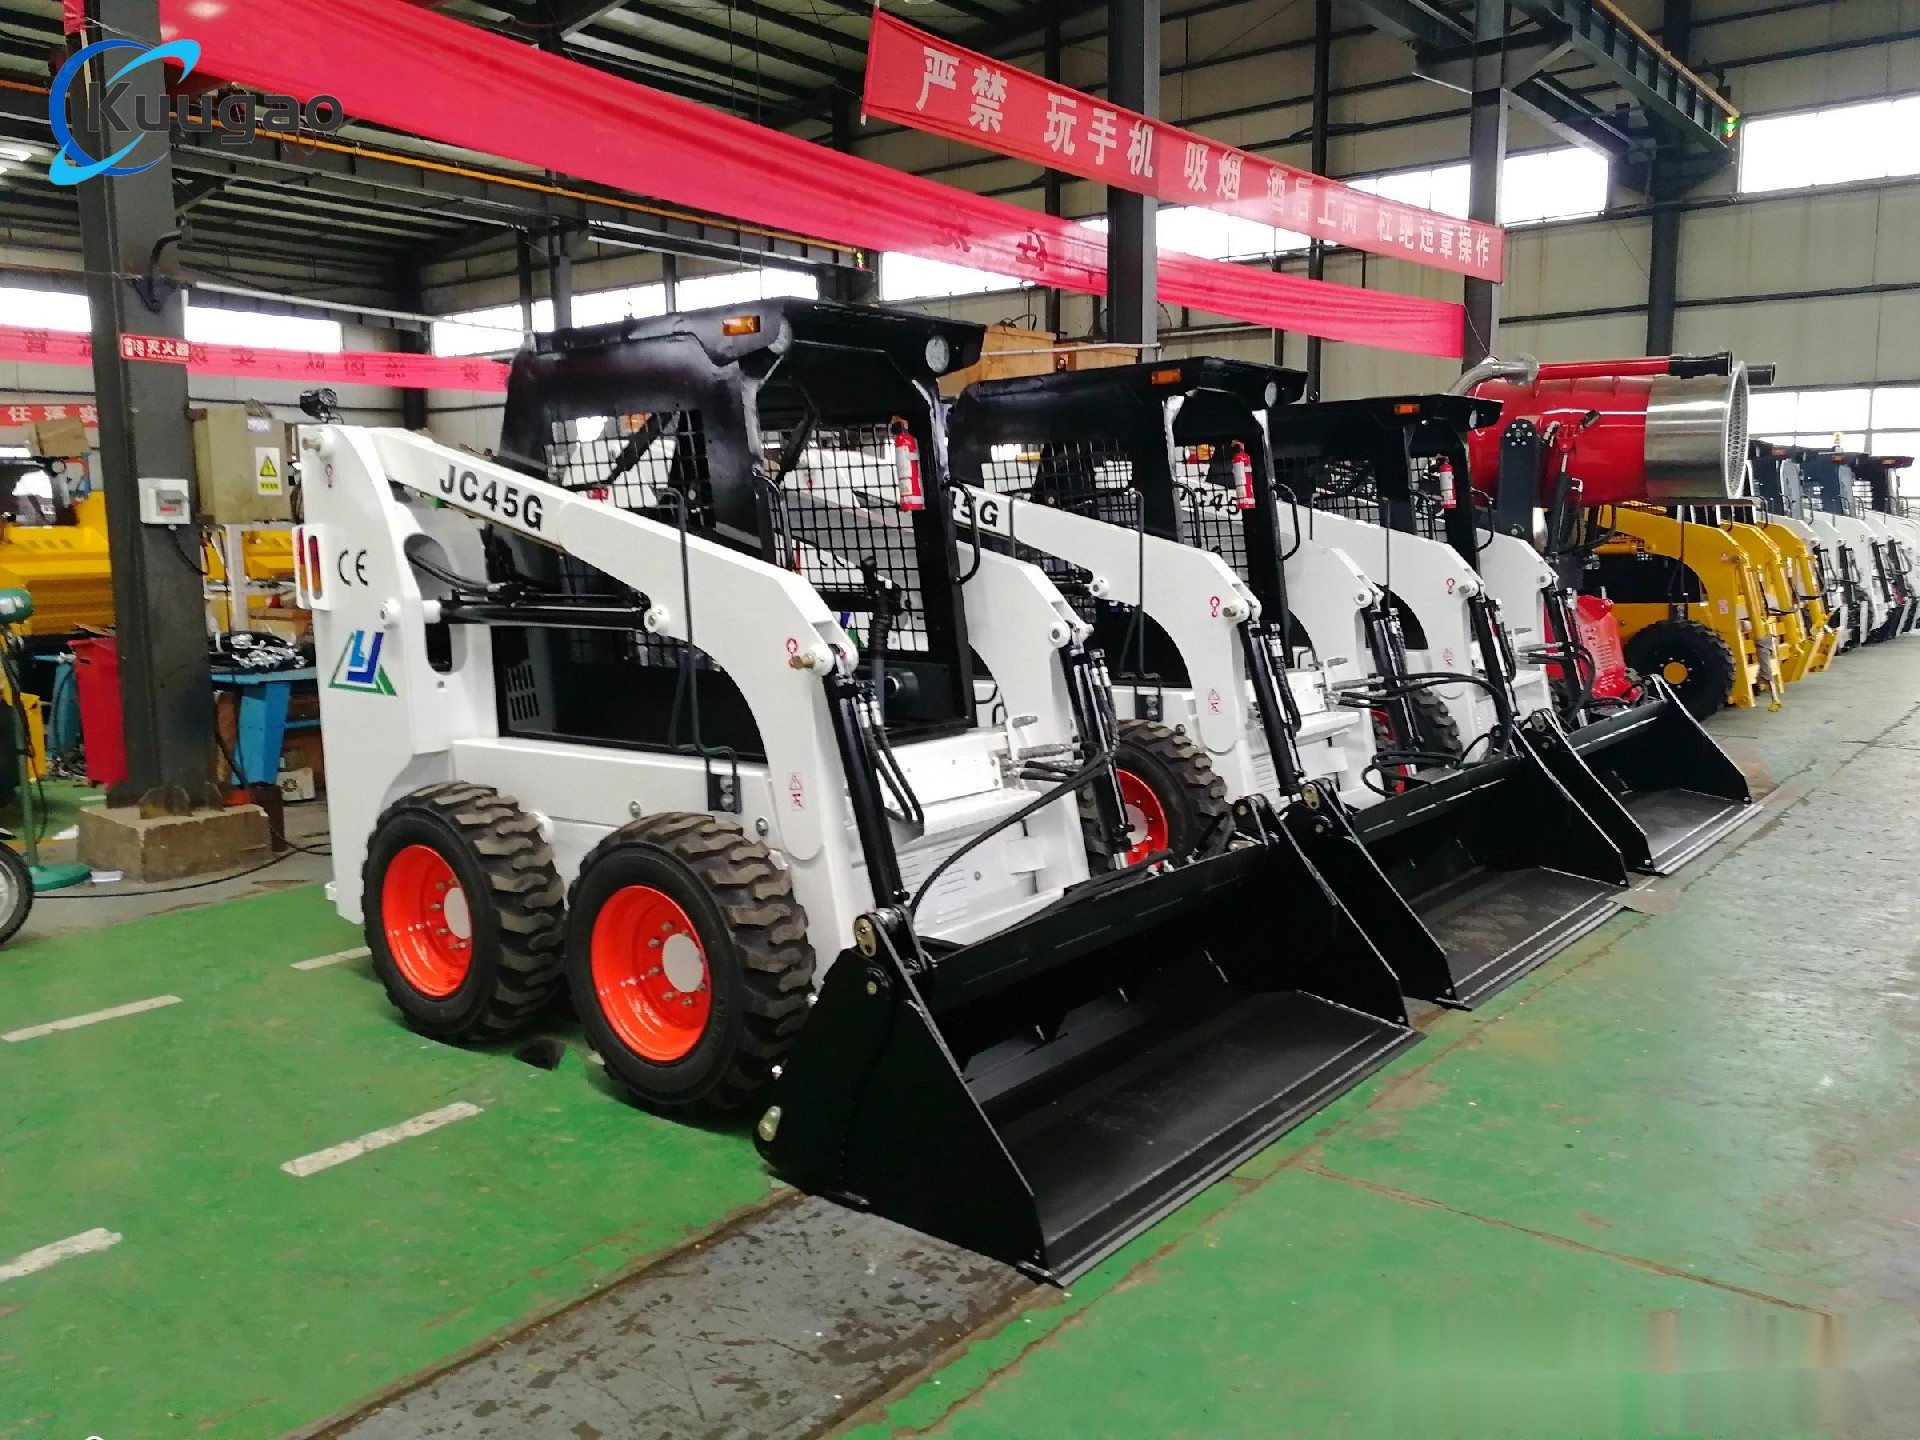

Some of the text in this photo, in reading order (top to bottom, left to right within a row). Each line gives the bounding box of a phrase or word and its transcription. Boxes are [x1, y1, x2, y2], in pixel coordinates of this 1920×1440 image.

[915, 46, 1008, 134] 严禁
[1043, 91, 1155, 178] 玩手机
[1184, 141, 1244, 202] 吸烟
[439, 464, 544, 532] JC45G
[337, 549, 369, 587] CE
